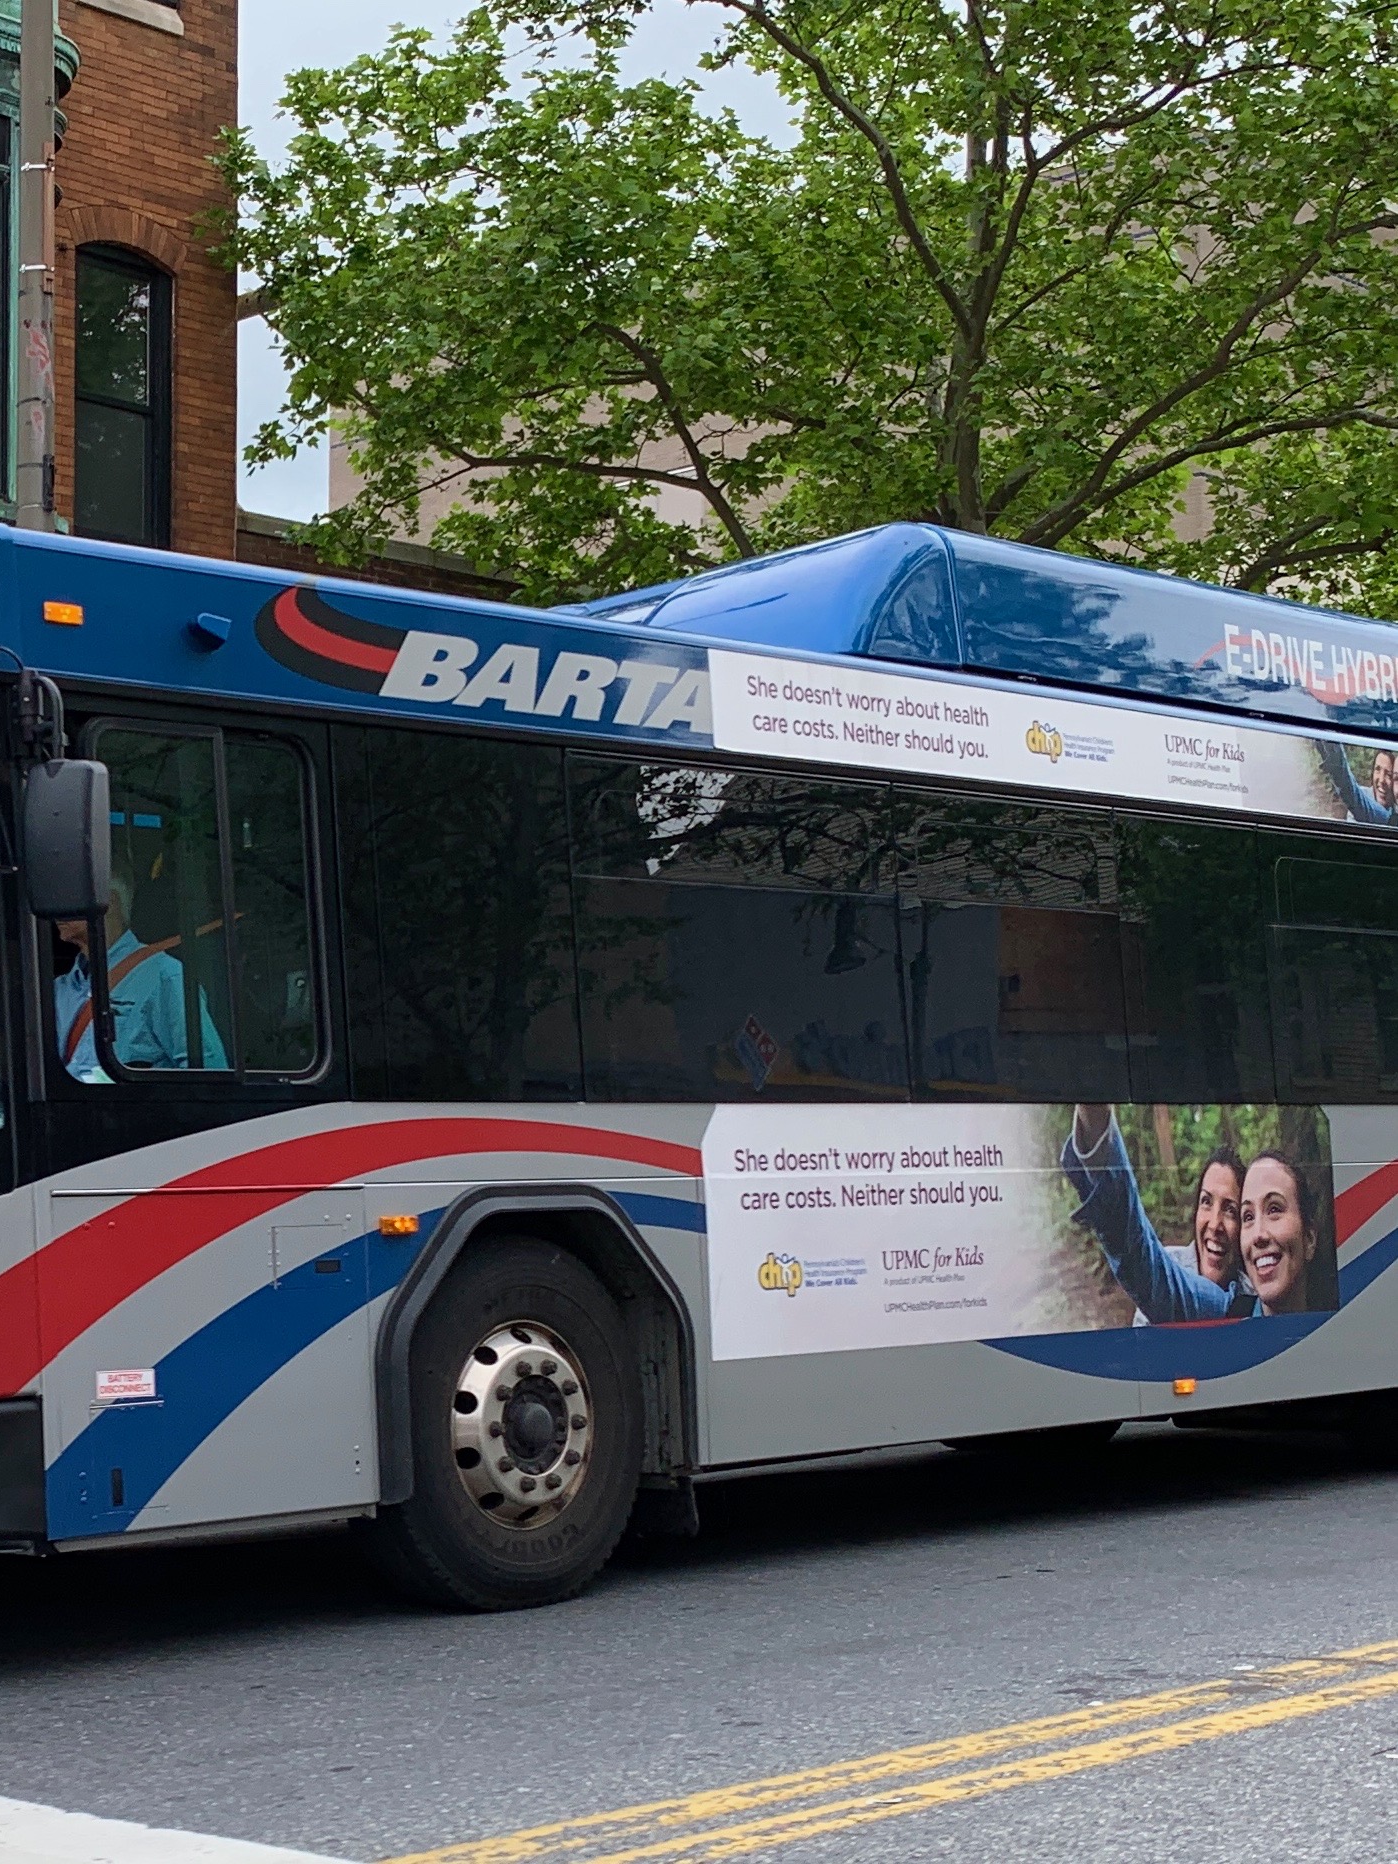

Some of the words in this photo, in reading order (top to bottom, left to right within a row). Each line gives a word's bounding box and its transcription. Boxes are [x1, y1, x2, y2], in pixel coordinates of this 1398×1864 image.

[1224, 623, 1326, 690] E-DRIVE
[379, 629, 714, 734] BARTA
[747, 675, 777, 699] She
[783, 680, 843, 707] doesn't
[846, 693, 892, 718] worry
[896, 697, 940, 721] about
[944, 702, 990, 727] health
[752, 713, 788, 734] care
[793, 718, 839, 740] costs.
[843, 721, 900, 748] Neither
[904, 729, 954, 754] should
[958, 740, 989, 760] you.
[1164, 734, 1203, 756] UPMC
[1205, 739, 1220, 761] for
[1222, 743, 1245, 762] Kids
[734, 1148, 768, 1172] She
[774, 1148, 841, 1171] doesn't
[845, 1151, 895, 1173] worry
[901, 1146, 949, 1168] about
[954, 1145, 1003, 1167] health
[740, 1191, 780, 1210] care
[785, 1187, 836, 1208] costs.
[841, 1183, 905, 1206] Neither
[910, 1181, 964, 1204] should
[969, 1184, 1003, 1207] you.
[882, 1248, 930, 1271] UPMC
[932, 1246, 952, 1273] for
[954, 1245, 984, 1267] Kids
